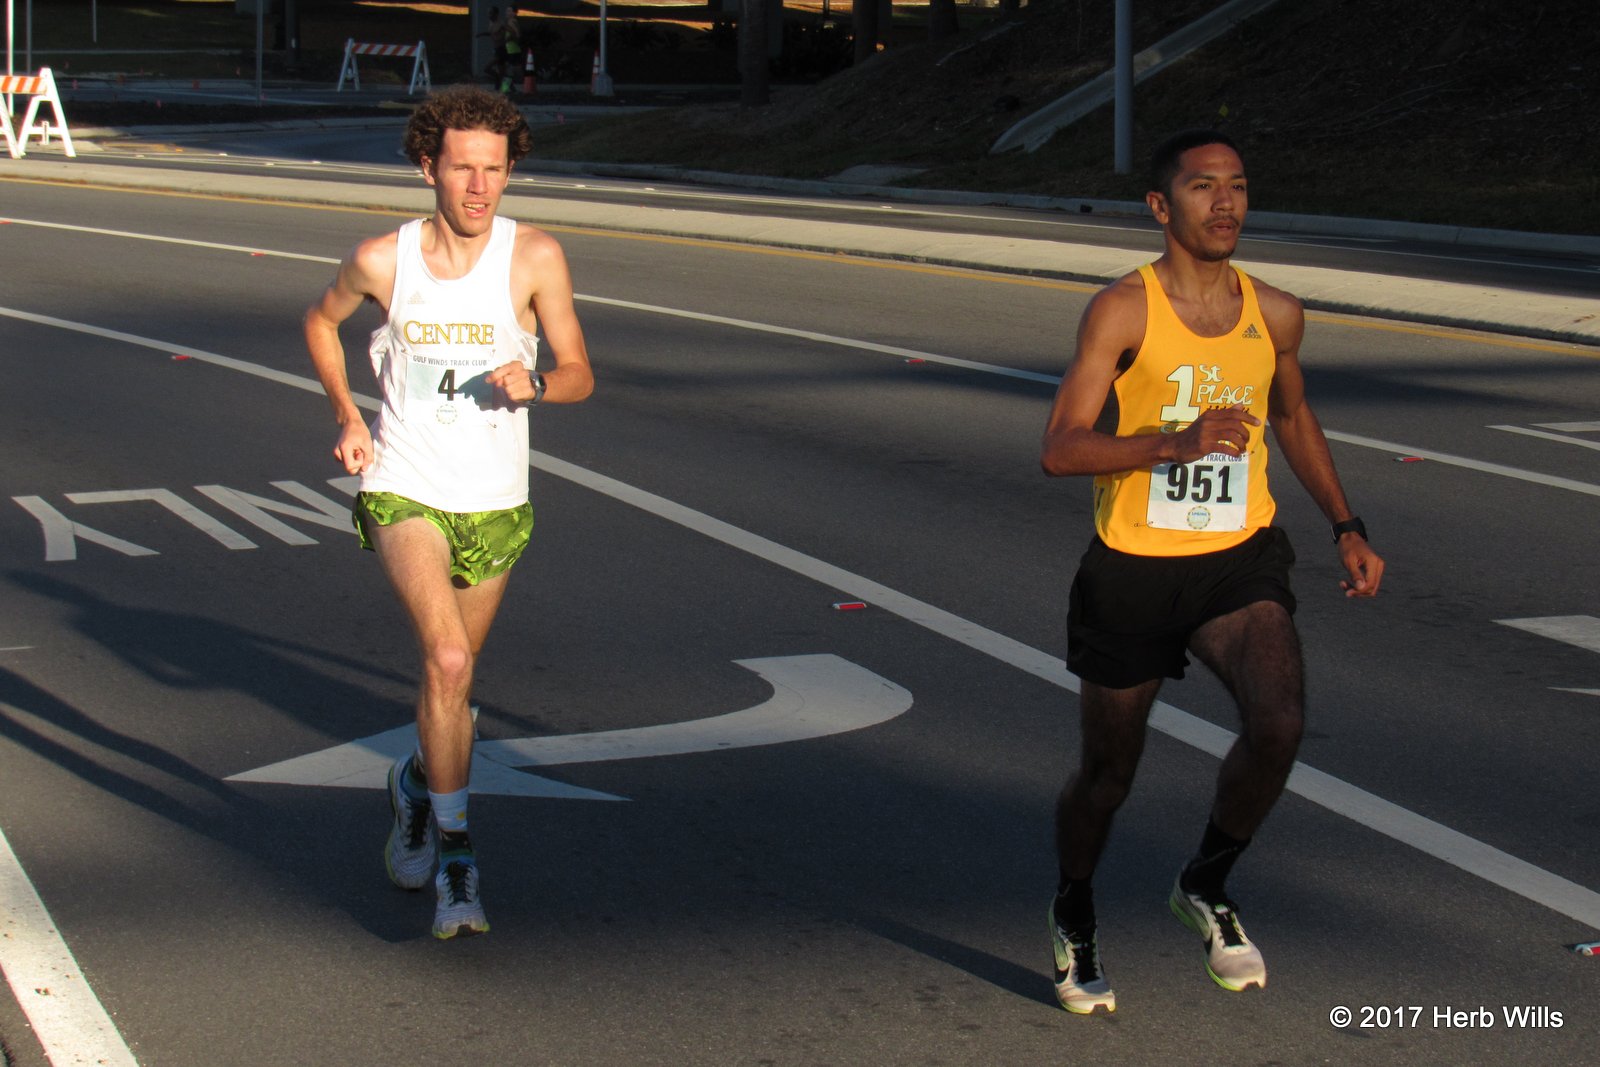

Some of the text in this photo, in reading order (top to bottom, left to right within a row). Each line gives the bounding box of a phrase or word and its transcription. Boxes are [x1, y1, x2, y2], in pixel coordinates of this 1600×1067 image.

[403, 320, 495, 345] CENTRE
[413, 354, 488, 367] GULF WINDS TRACK CLUB
[437, 369, 458, 401] 4
[1197, 384, 1255, 405] PLACE
[1166, 463, 1233, 504] 951
[11, 475, 362, 562] NLY
